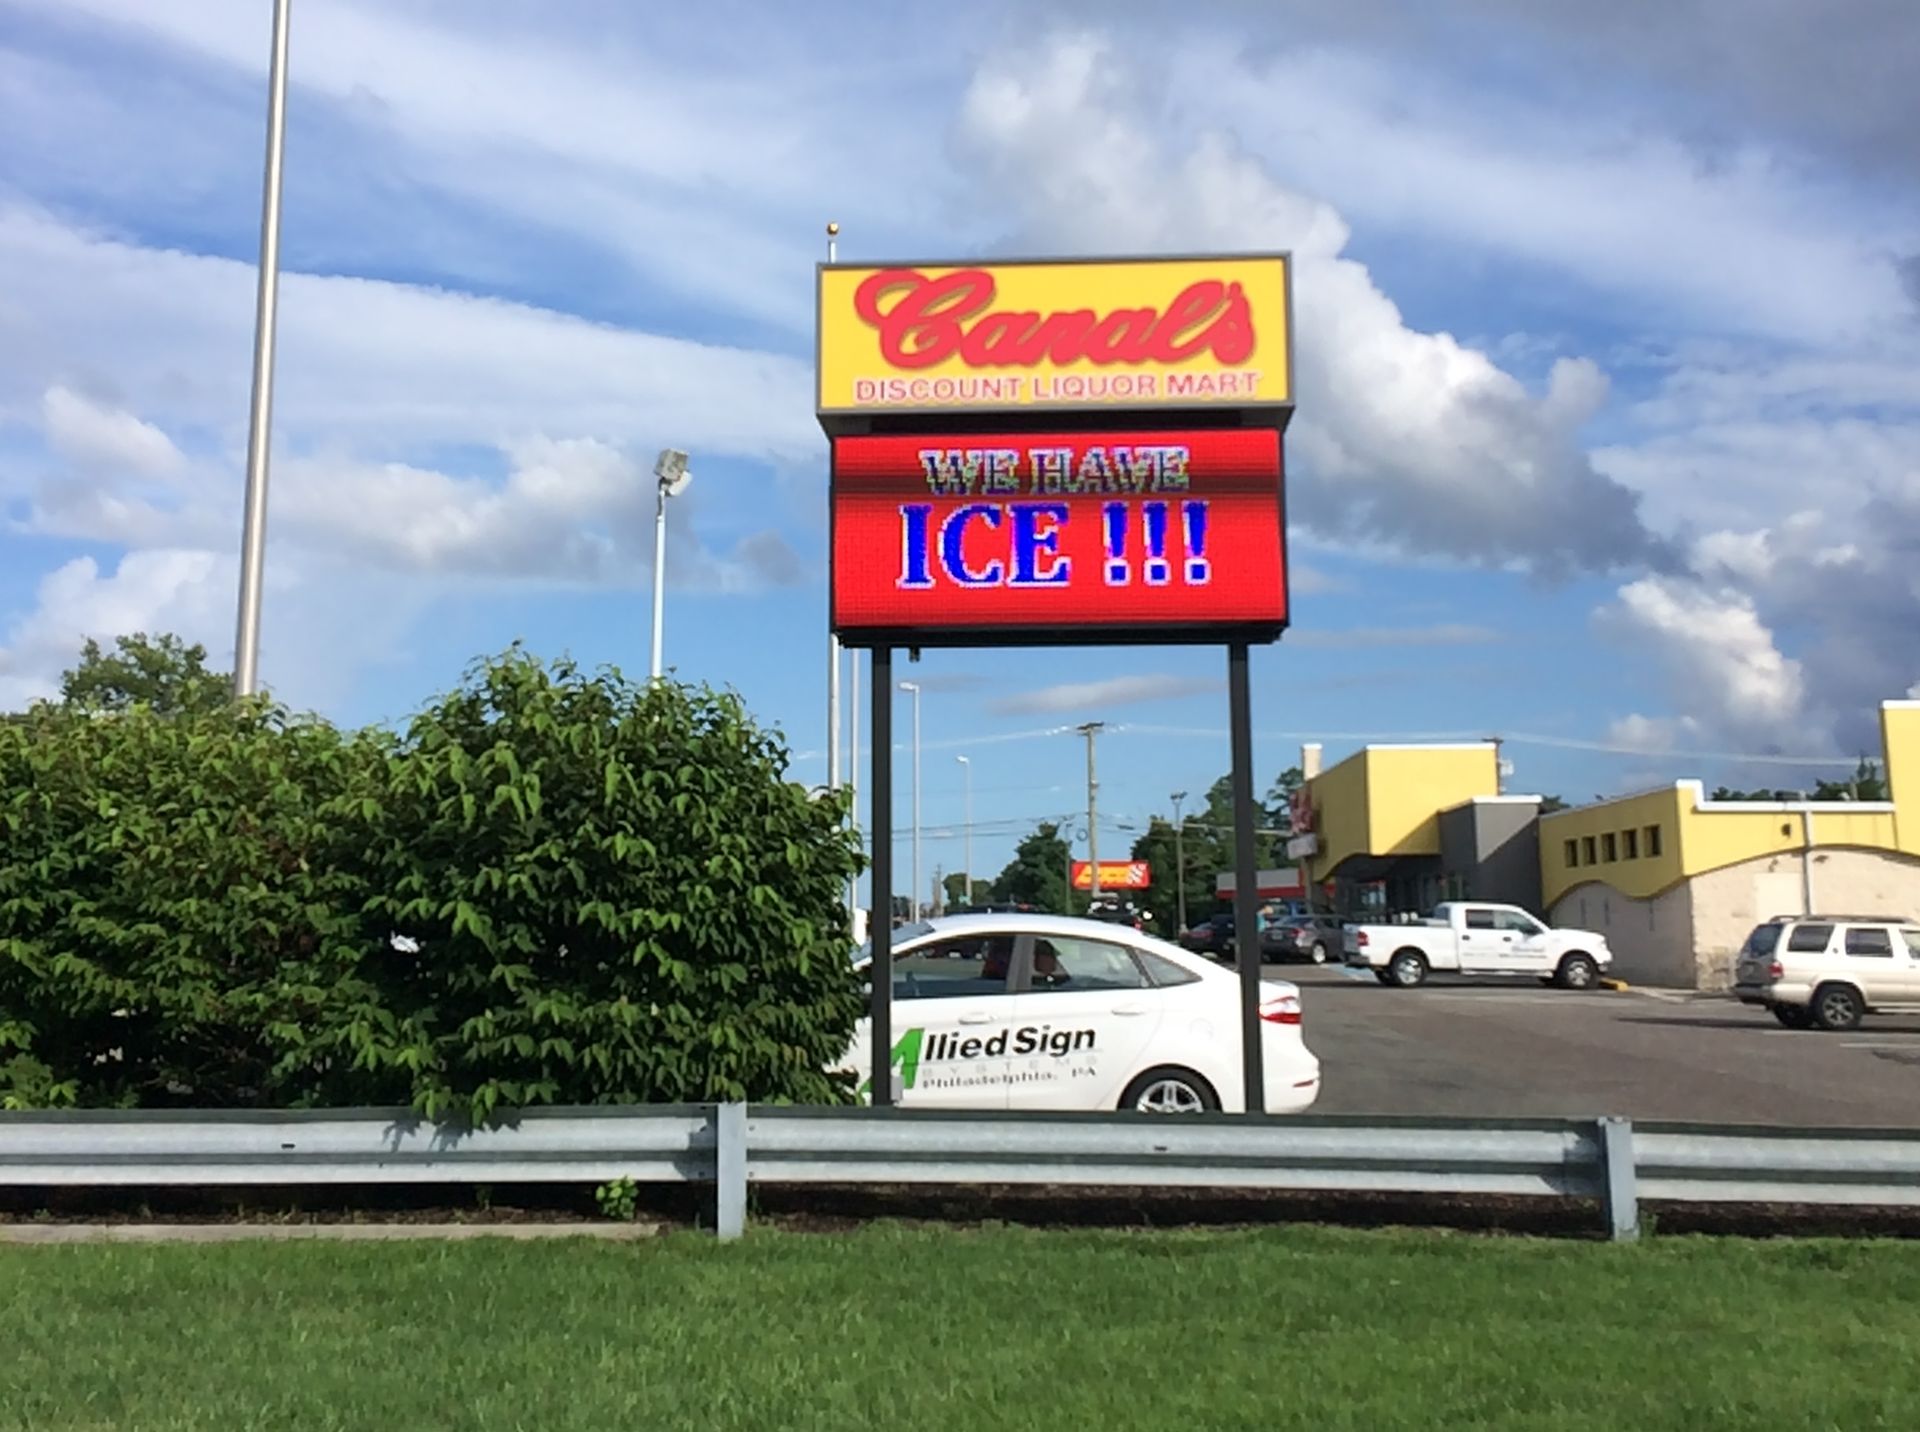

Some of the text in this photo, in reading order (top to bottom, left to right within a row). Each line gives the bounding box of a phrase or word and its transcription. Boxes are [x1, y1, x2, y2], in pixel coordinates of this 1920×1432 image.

[854, 269, 1256, 370] Canal's
[855, 371, 1260, 402] DISCOUNT LIQUOR MART
[919, 446, 1190, 495] WE HAVE
[896, 499, 1212, 589] ICE !!!
[1013, 1025, 1096, 1057] Sign
